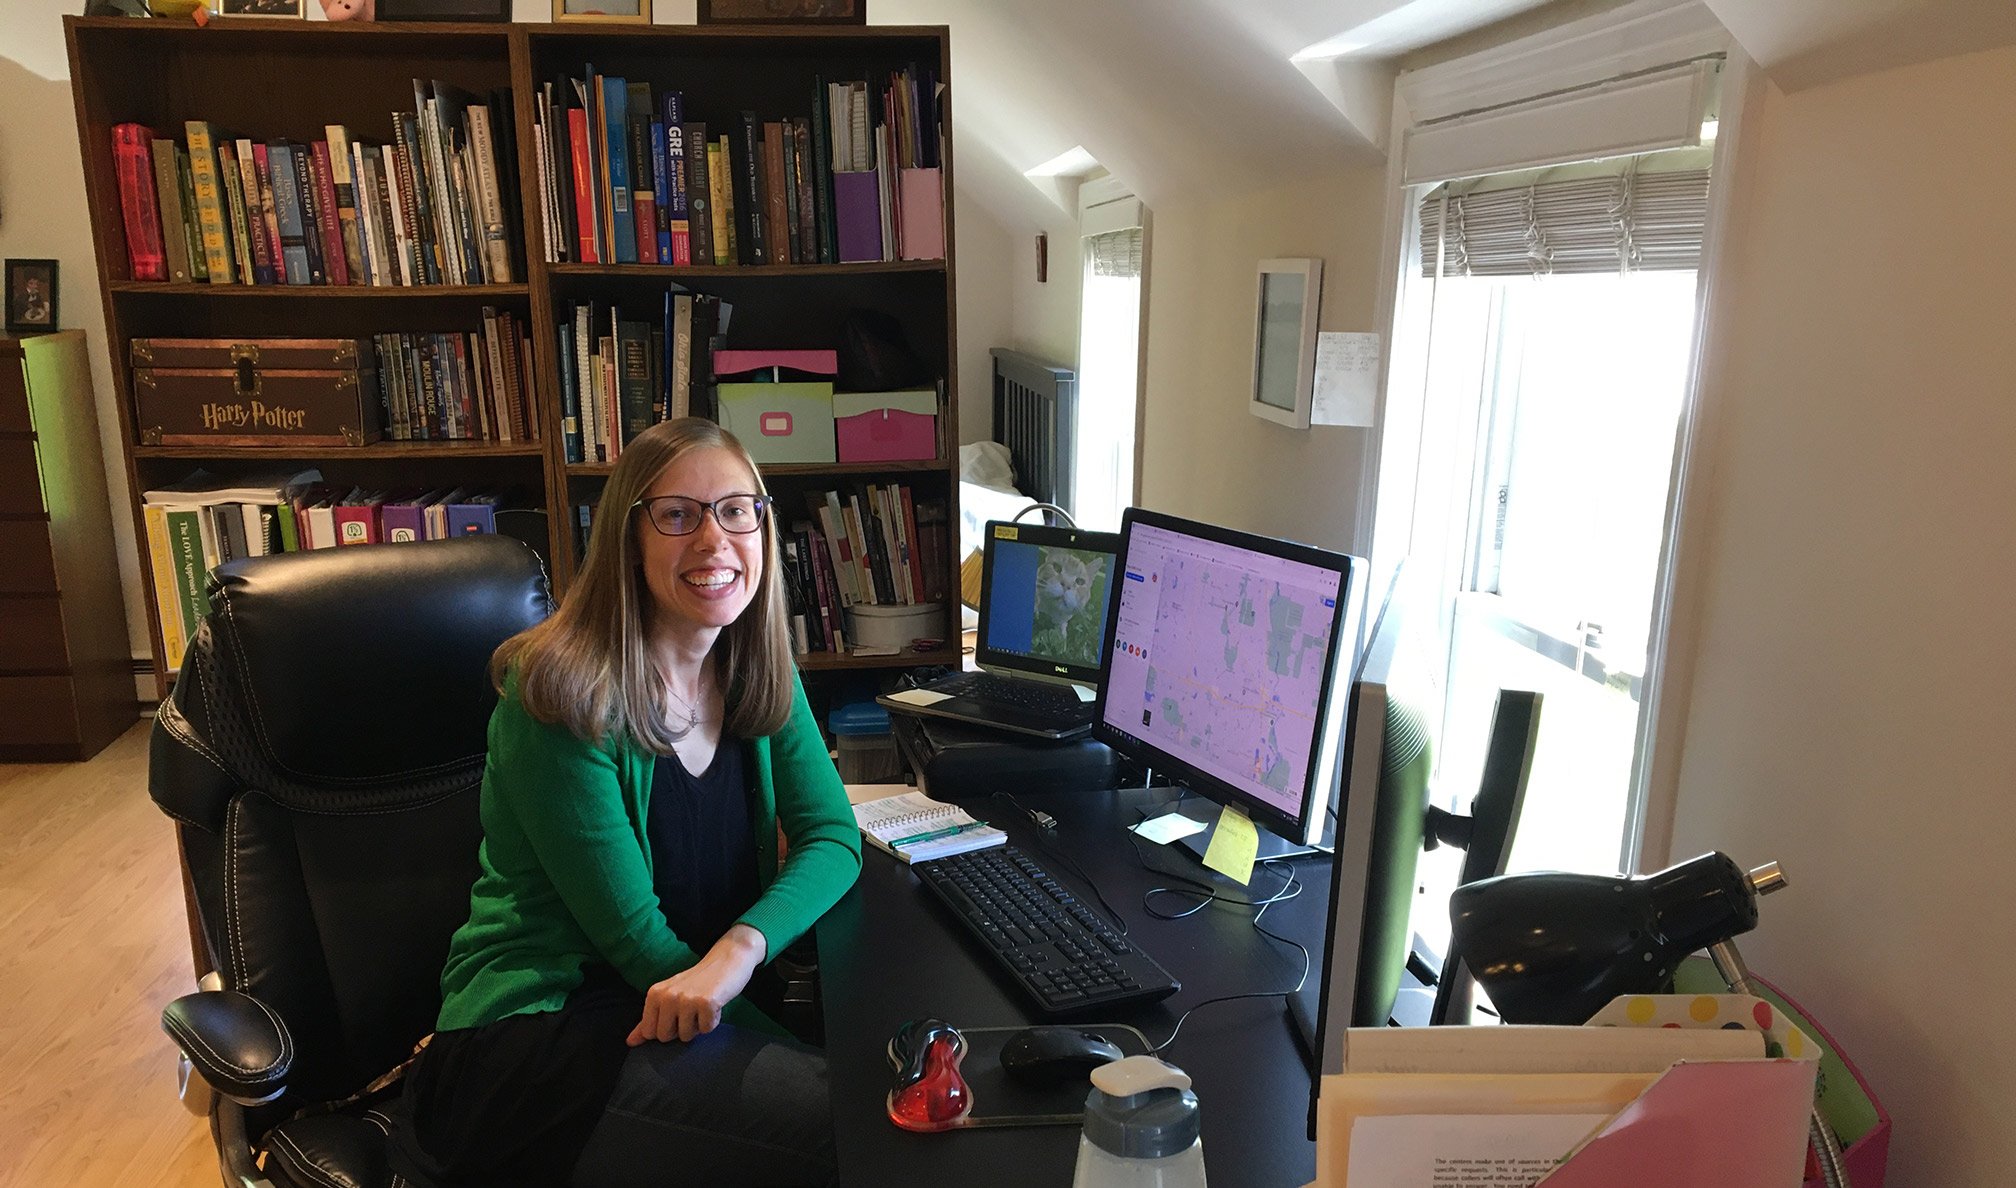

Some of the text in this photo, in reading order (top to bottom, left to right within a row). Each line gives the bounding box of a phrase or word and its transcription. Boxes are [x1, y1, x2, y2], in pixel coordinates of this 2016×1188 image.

[479, 136, 489, 164] MOODY
[669, 126, 683, 156] GRE
[693, 132, 705, 188] CHURCH HISTORY
[198, 156, 212, 199] STORY
[297, 152, 313, 218] BEYOND THERAPY
[319, 167, 328, 189] WHO
[379, 176, 390, 203] JUST
[483, 166, 492, 190] ATLAS
[676, 160, 688, 211] PREMIER 2016
[243, 161, 258, 205] MORALITY
[252, 216, 266, 256] PRACTICE
[279, 198, 290, 224] Greek
[322, 190, 332, 213] GIVES
[326, 214, 335, 230] LIFE
[677, 333, 689, 359] Ohio
[422, 361, 437, 415] MOULIN ROUGE
[676, 361, 689, 391] State
[202, 400, 305, 430] Harry Potter
[180, 521, 189, 536] The
[182, 537, 193, 561] LOVE
[185, 562, 199, 595] Approach
